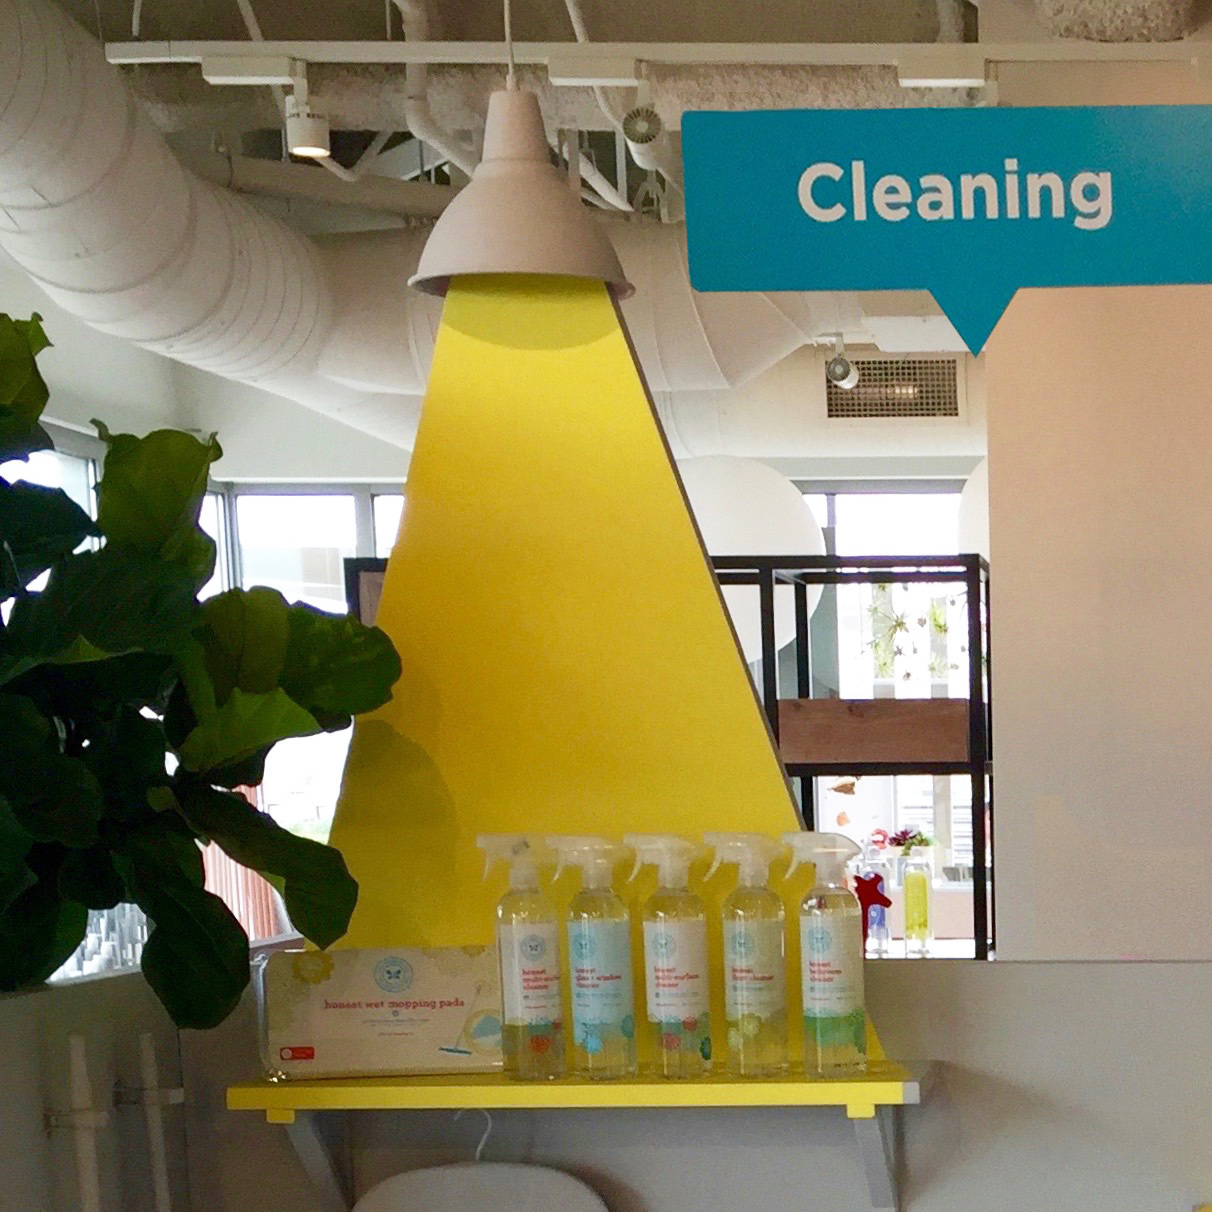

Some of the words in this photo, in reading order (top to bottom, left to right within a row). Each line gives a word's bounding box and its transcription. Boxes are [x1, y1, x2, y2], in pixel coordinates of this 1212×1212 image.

[798, 158, 1113, 231] Cleaning
[323, 1000, 363, 1010] honest
[365, 1000, 385, 1010] wet
[387, 1000, 437, 1011] mopping
[439, 998, 466, 1010] pads
